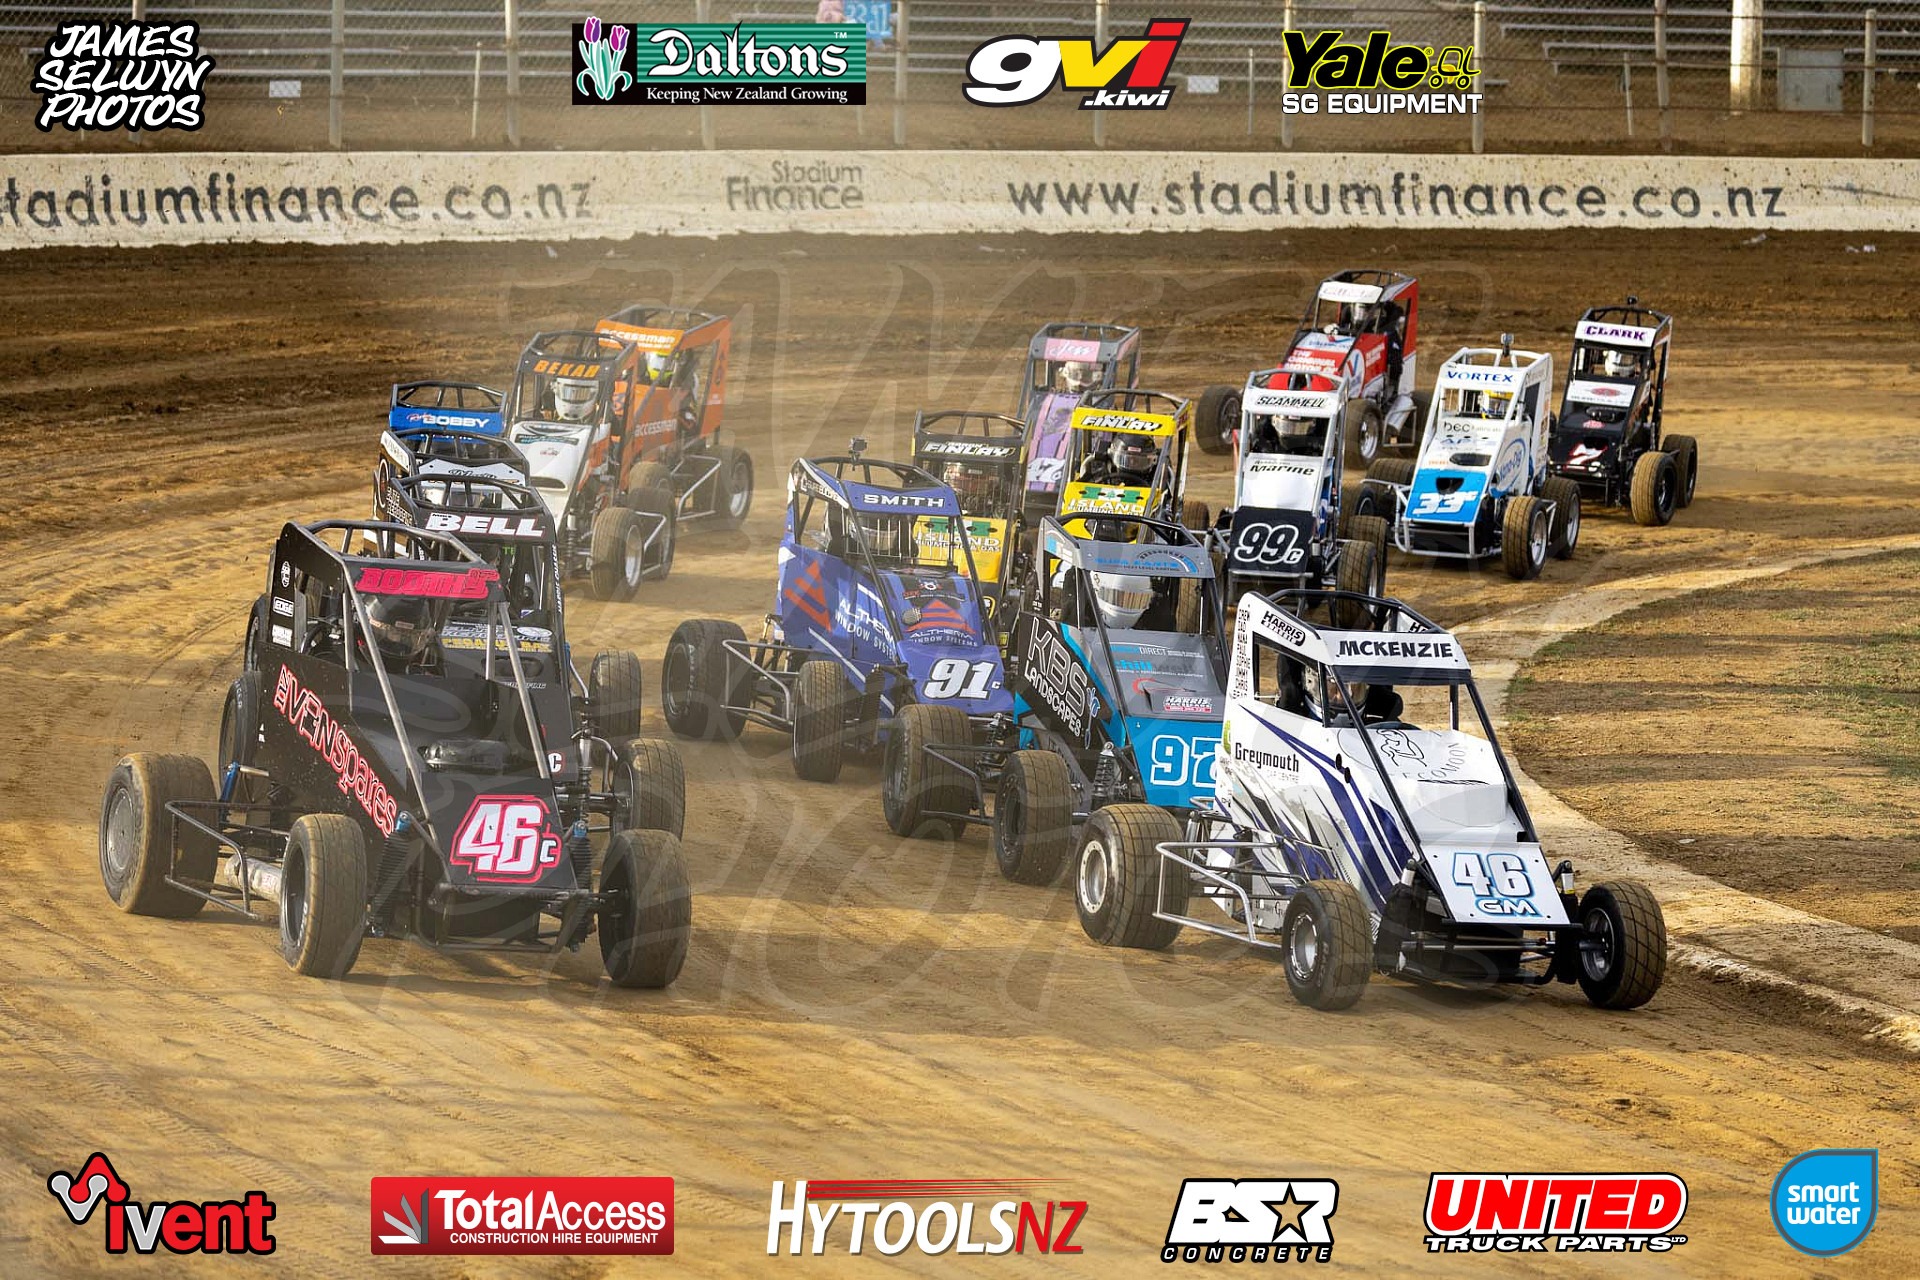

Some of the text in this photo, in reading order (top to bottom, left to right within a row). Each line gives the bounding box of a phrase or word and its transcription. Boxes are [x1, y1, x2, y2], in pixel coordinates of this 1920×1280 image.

[772, 160, 863, 184] Stadium
[0, 173, 595, 229] tadiumfinance.co.nz
[726, 176, 864, 211] Finance
[1009, 170, 1787, 219] www.stadiumfinance.co.nz
[1585, 325, 1648, 342] CLARK
[533, 360, 601, 378] BEKAH
[1447, 371, 1513, 383] VORTEX
[1257, 396, 1325, 408] SCAMMELL
[423, 416, 490, 428] BOBBY
[1082, 417, 1160, 431] FINLAY
[924, 442, 1009, 457] FINLAY
[1250, 465, 1315, 476] Marine
[864, 494, 945, 508] SMITH
[1069, 500, 1143, 513] ISLAND
[426, 513, 544, 537] BELL
[1263, 611, 1303, 640] HARRIS
[910, 629, 974, 641] ALTHERM
[1140, 646, 1166, 656] DIRECT
[1339, 640, 1453, 657] MCKENZIE
[1029, 617, 1088, 717] KBS
[1024, 661, 1082, 738] LANDSCAPES
[1235, 742, 1299, 772] Greymouth
[1453, 853, 1532, 898] 46
[1475, 900, 1541, 917] GM
